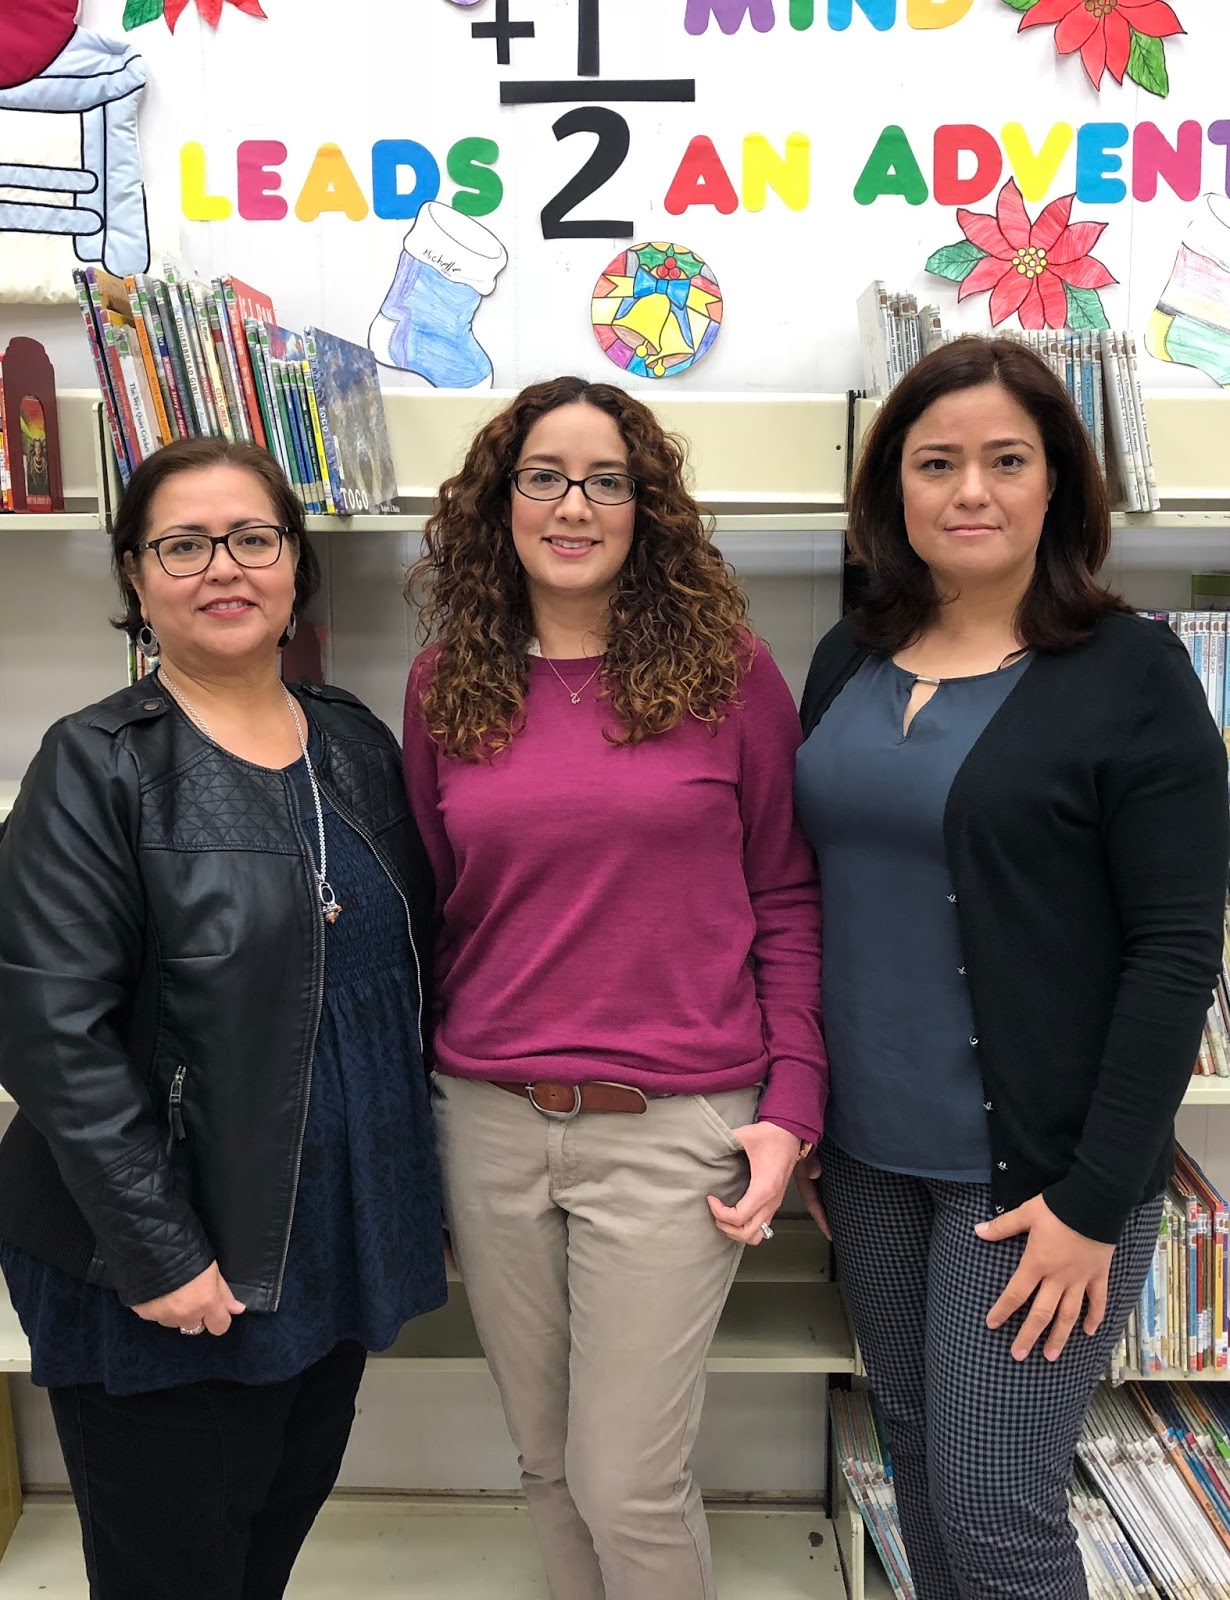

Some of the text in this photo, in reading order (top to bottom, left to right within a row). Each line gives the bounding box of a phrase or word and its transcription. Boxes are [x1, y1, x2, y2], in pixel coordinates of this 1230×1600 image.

[180, 137, 504, 222] LEADS
[541, 106, 634, 239] 2
[664, 132, 811, 215] AN
[422, 248, 462, 273] Michelle
[175, 316, 194, 376] GINGERBREAD
[189, 376, 199, 396] GIRL
[235, 339, 244, 355] ZOO
[243, 376, 252, 394] Seuss
[128, 382, 152, 453] The Very Quiet Cricket
[170, 390, 180, 409] Story
[177, 418, 186, 437] Hope
[215, 387, 229, 427] CITY GREEN
[318, 405, 329, 432] TOGO
[1135, 385, 1143, 402] Picture
[1141, 423, 1150, 442] Eleanor
[1130, 432, 1139, 452] Kennedy
[339, 487, 368, 510] TOGO
